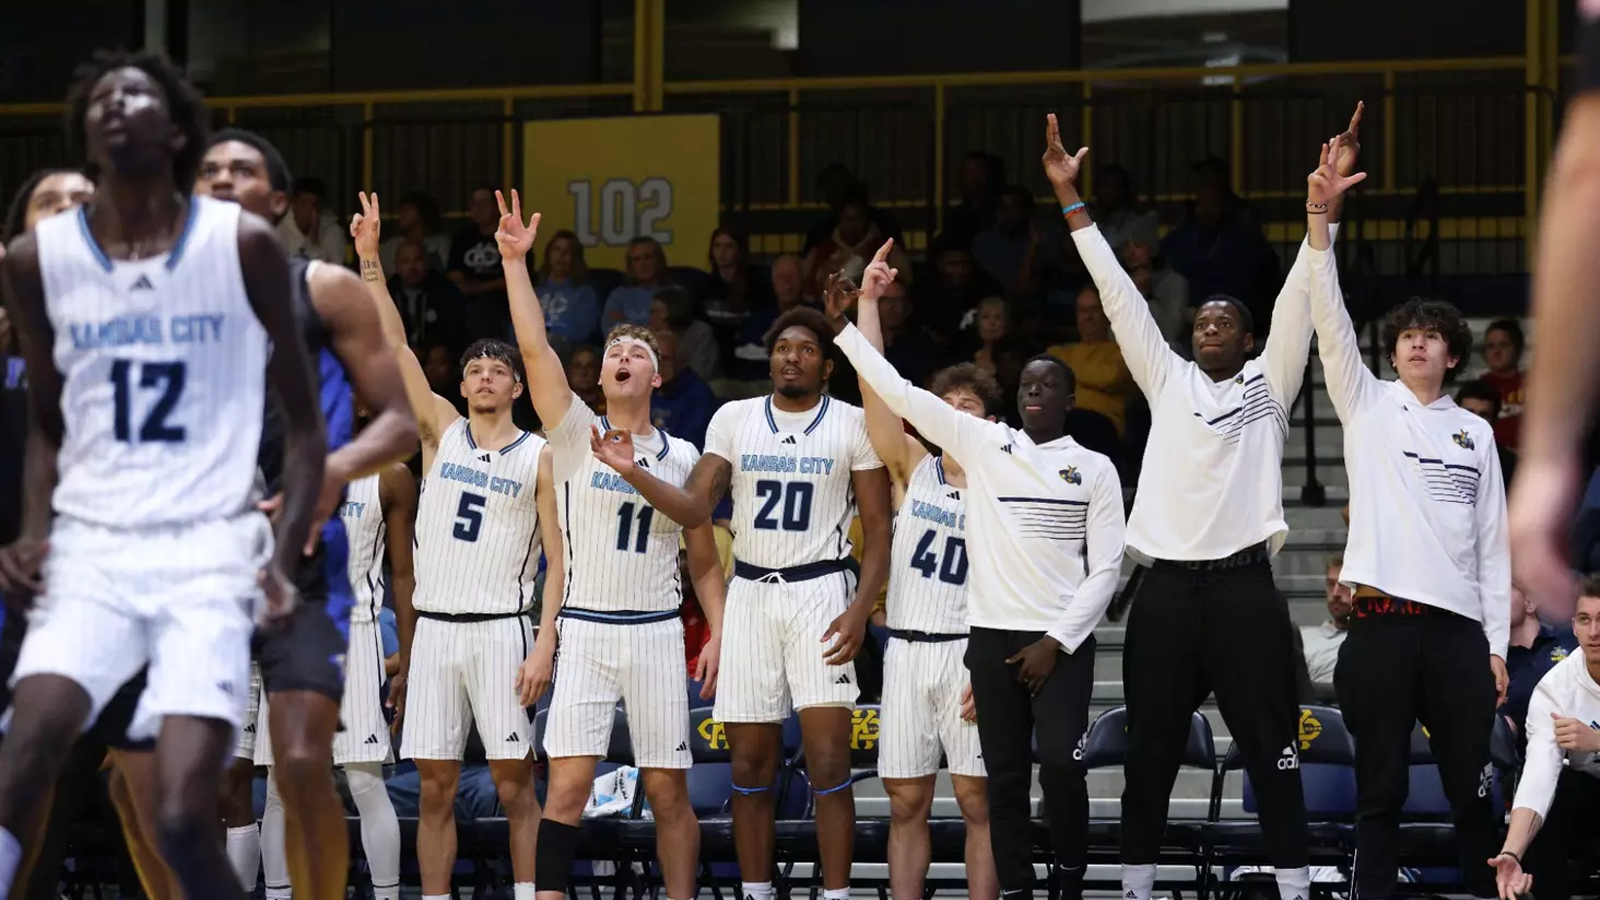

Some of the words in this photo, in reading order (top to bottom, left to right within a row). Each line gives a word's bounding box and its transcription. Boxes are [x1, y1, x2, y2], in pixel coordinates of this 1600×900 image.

[568, 177, 673, 248] 102
[171, 313, 222, 343] CITY
[110, 358, 186, 442] 12
[440, 462, 489, 488] KANSAS
[489, 476, 522, 498] CITY
[590, 471, 641, 495] KANS
[741, 454, 797, 472] KANSAS
[799, 457, 834, 475] CITY
[452, 491, 487, 542] 5
[617, 501, 654, 553] 11
[754, 479, 814, 531] 20
[911, 499, 957, 528] KANSAS
[910, 529, 969, 585] 40
